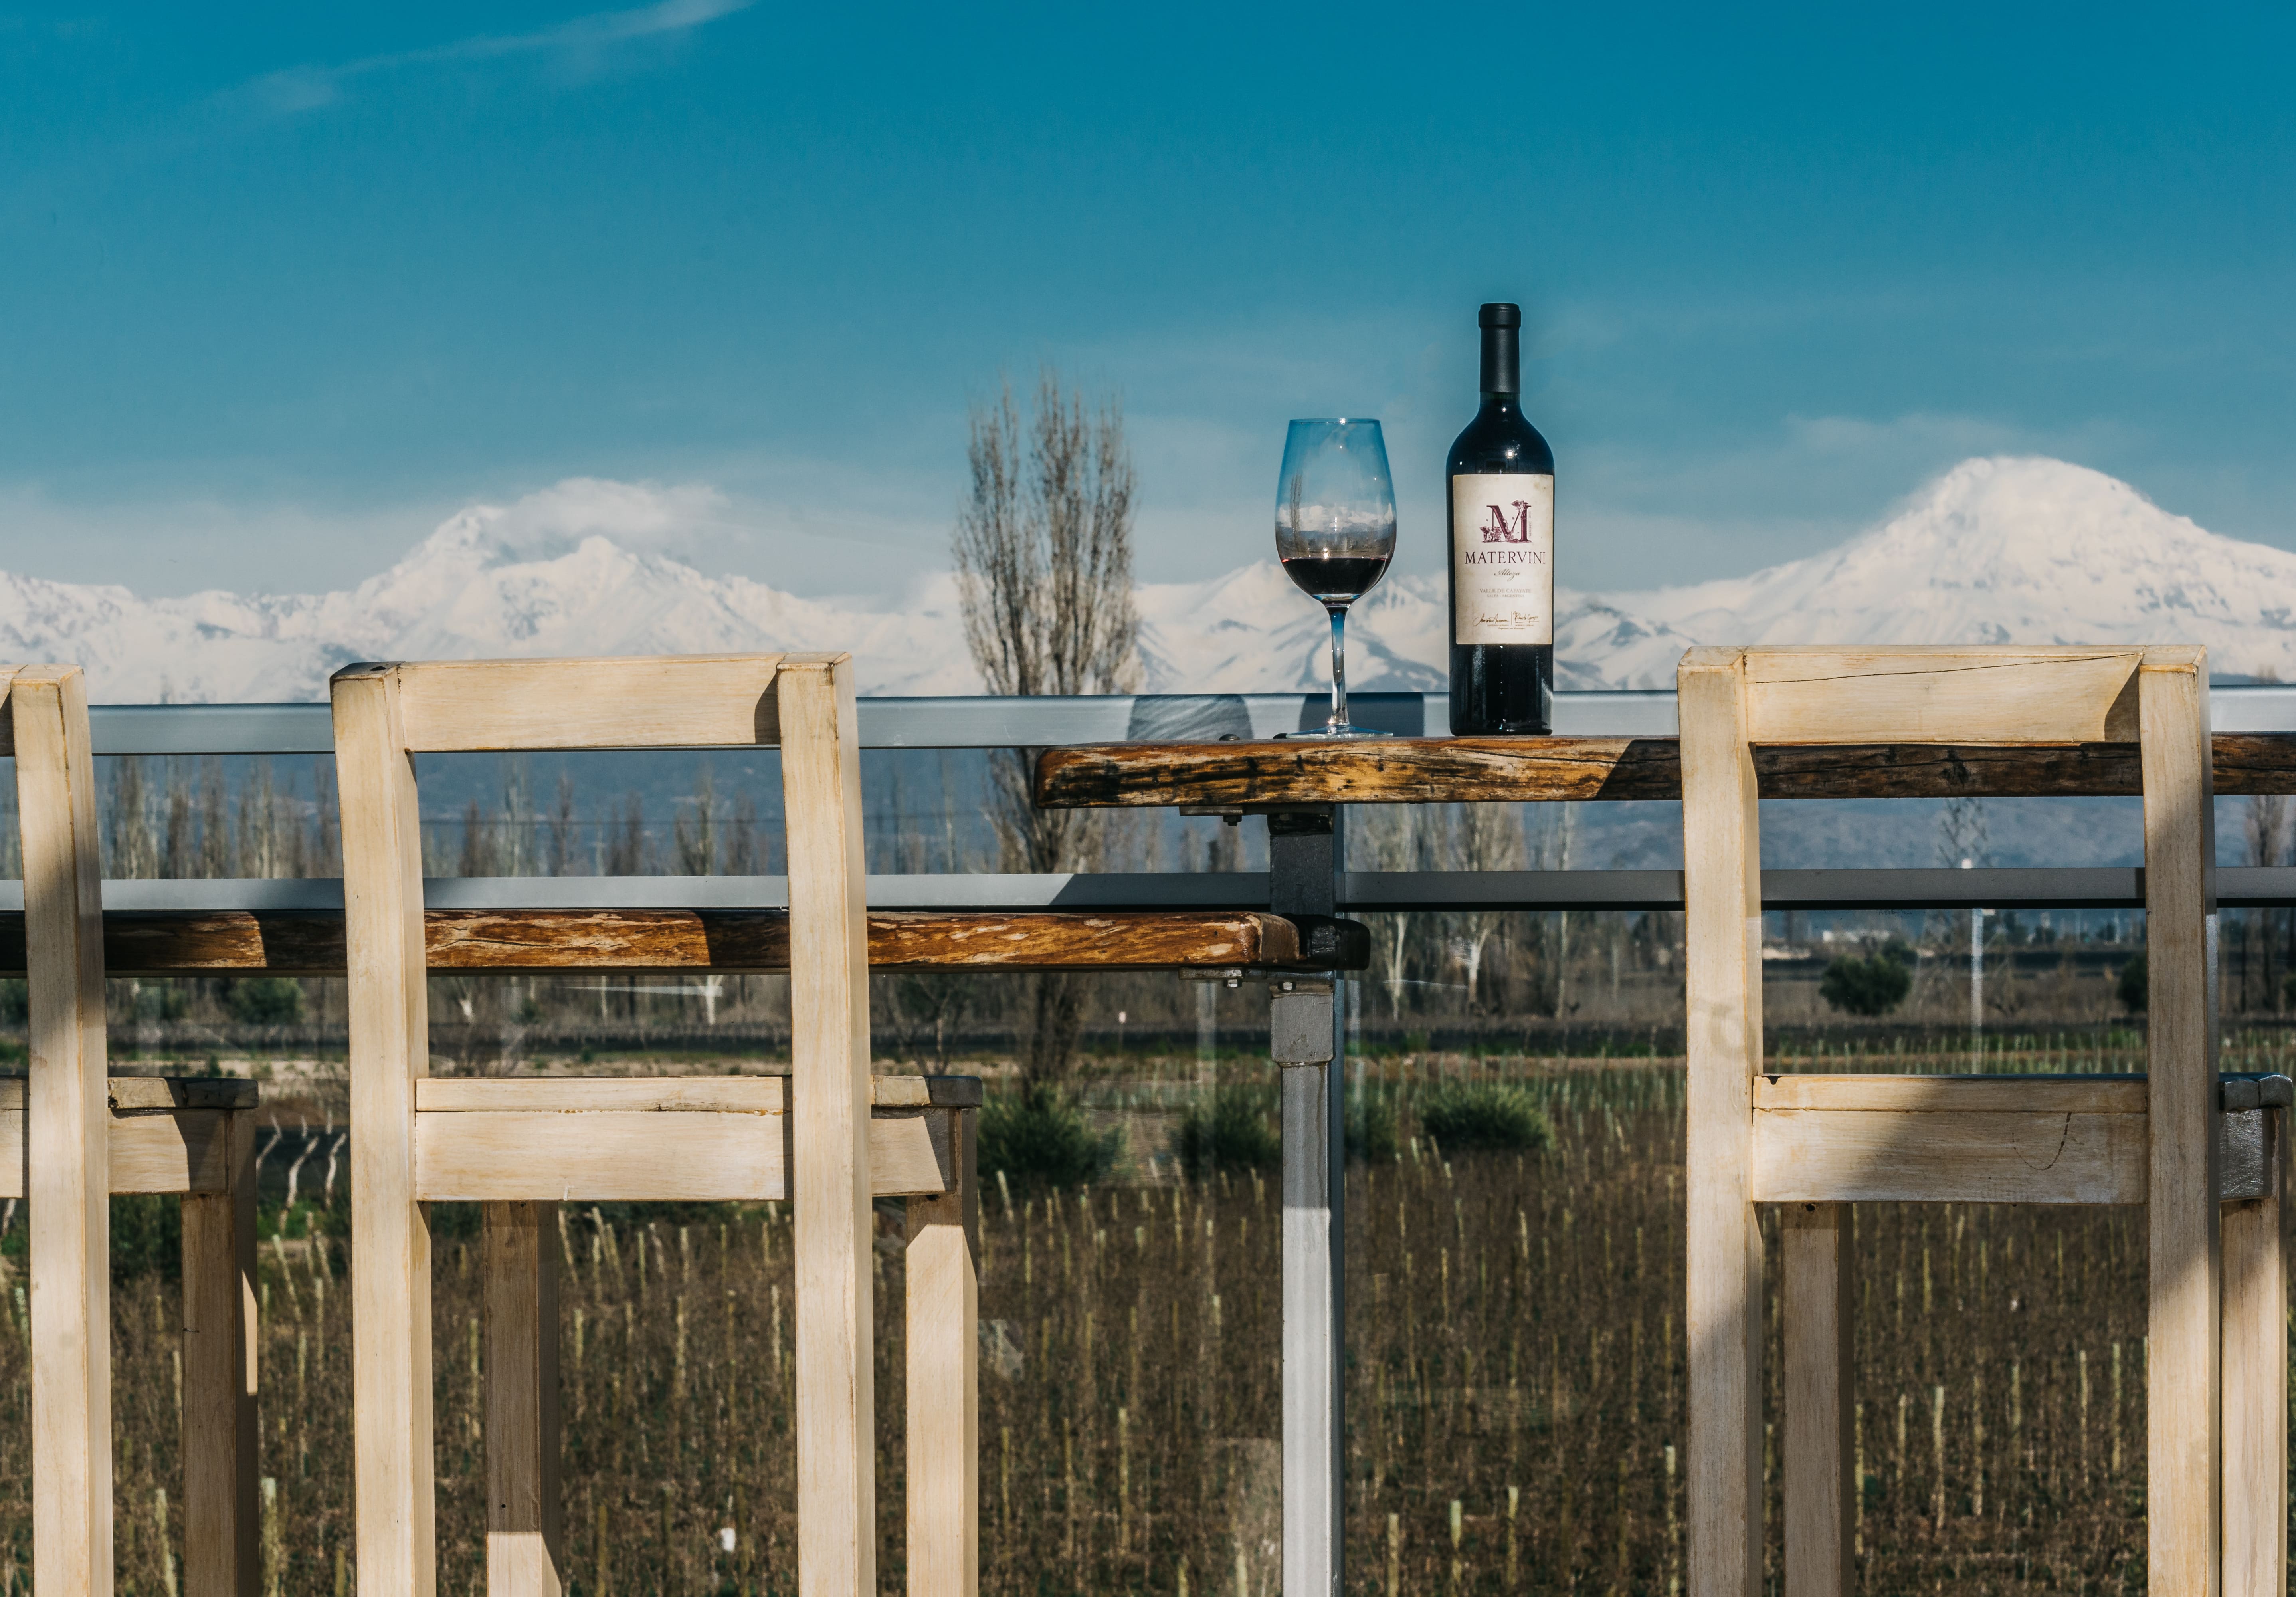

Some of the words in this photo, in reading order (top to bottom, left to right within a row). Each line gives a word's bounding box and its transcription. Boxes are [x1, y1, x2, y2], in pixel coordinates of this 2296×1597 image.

[1486, 505, 1532, 542] M
[1465, 551, 1546, 564] MATERVINI
[1494, 568, 1520, 581] Alteza
